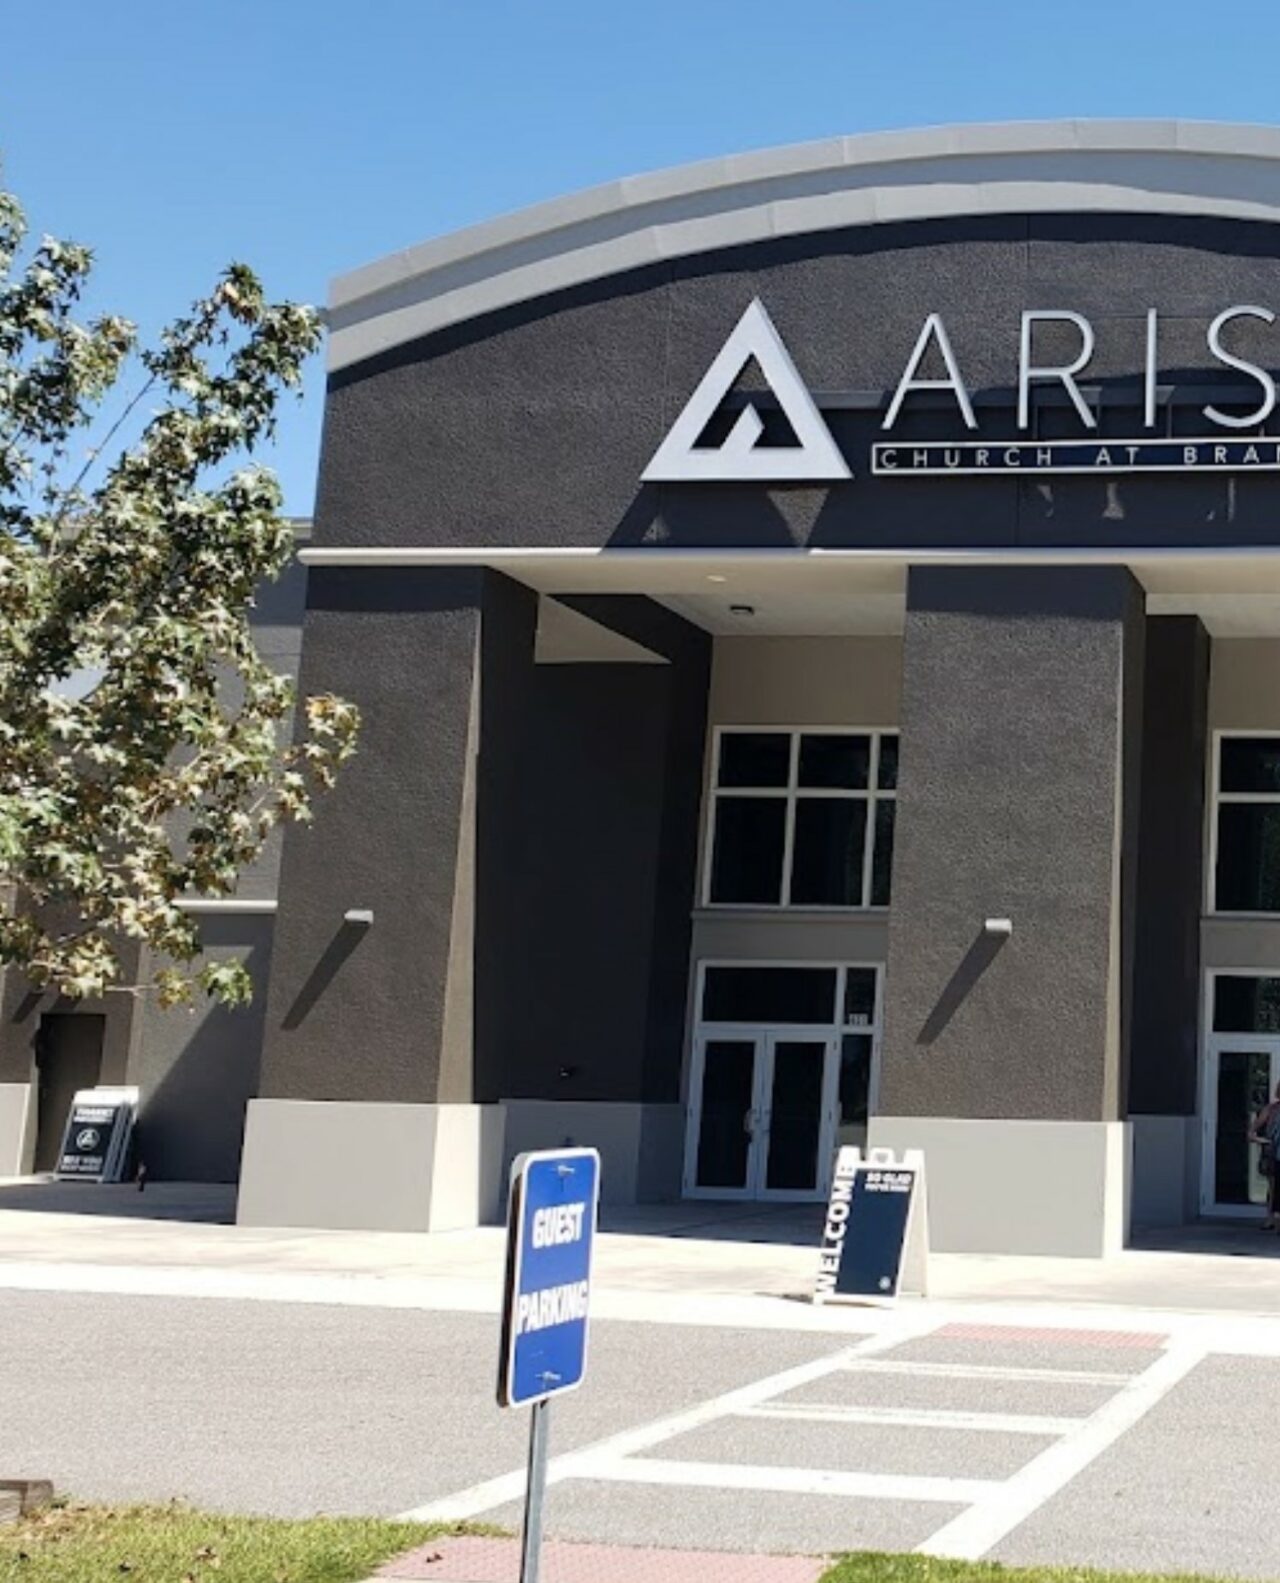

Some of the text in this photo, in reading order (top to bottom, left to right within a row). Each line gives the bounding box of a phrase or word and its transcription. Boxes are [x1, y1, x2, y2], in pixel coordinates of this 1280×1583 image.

[880, 446, 1051, 468] CHURCH
[1095, 446, 1140, 466] AT
[531, 1203, 585, 1249] GUEST
[814, 1164, 857, 1297] WELCOME
[517, 1280, 588, 1335] PARKING
